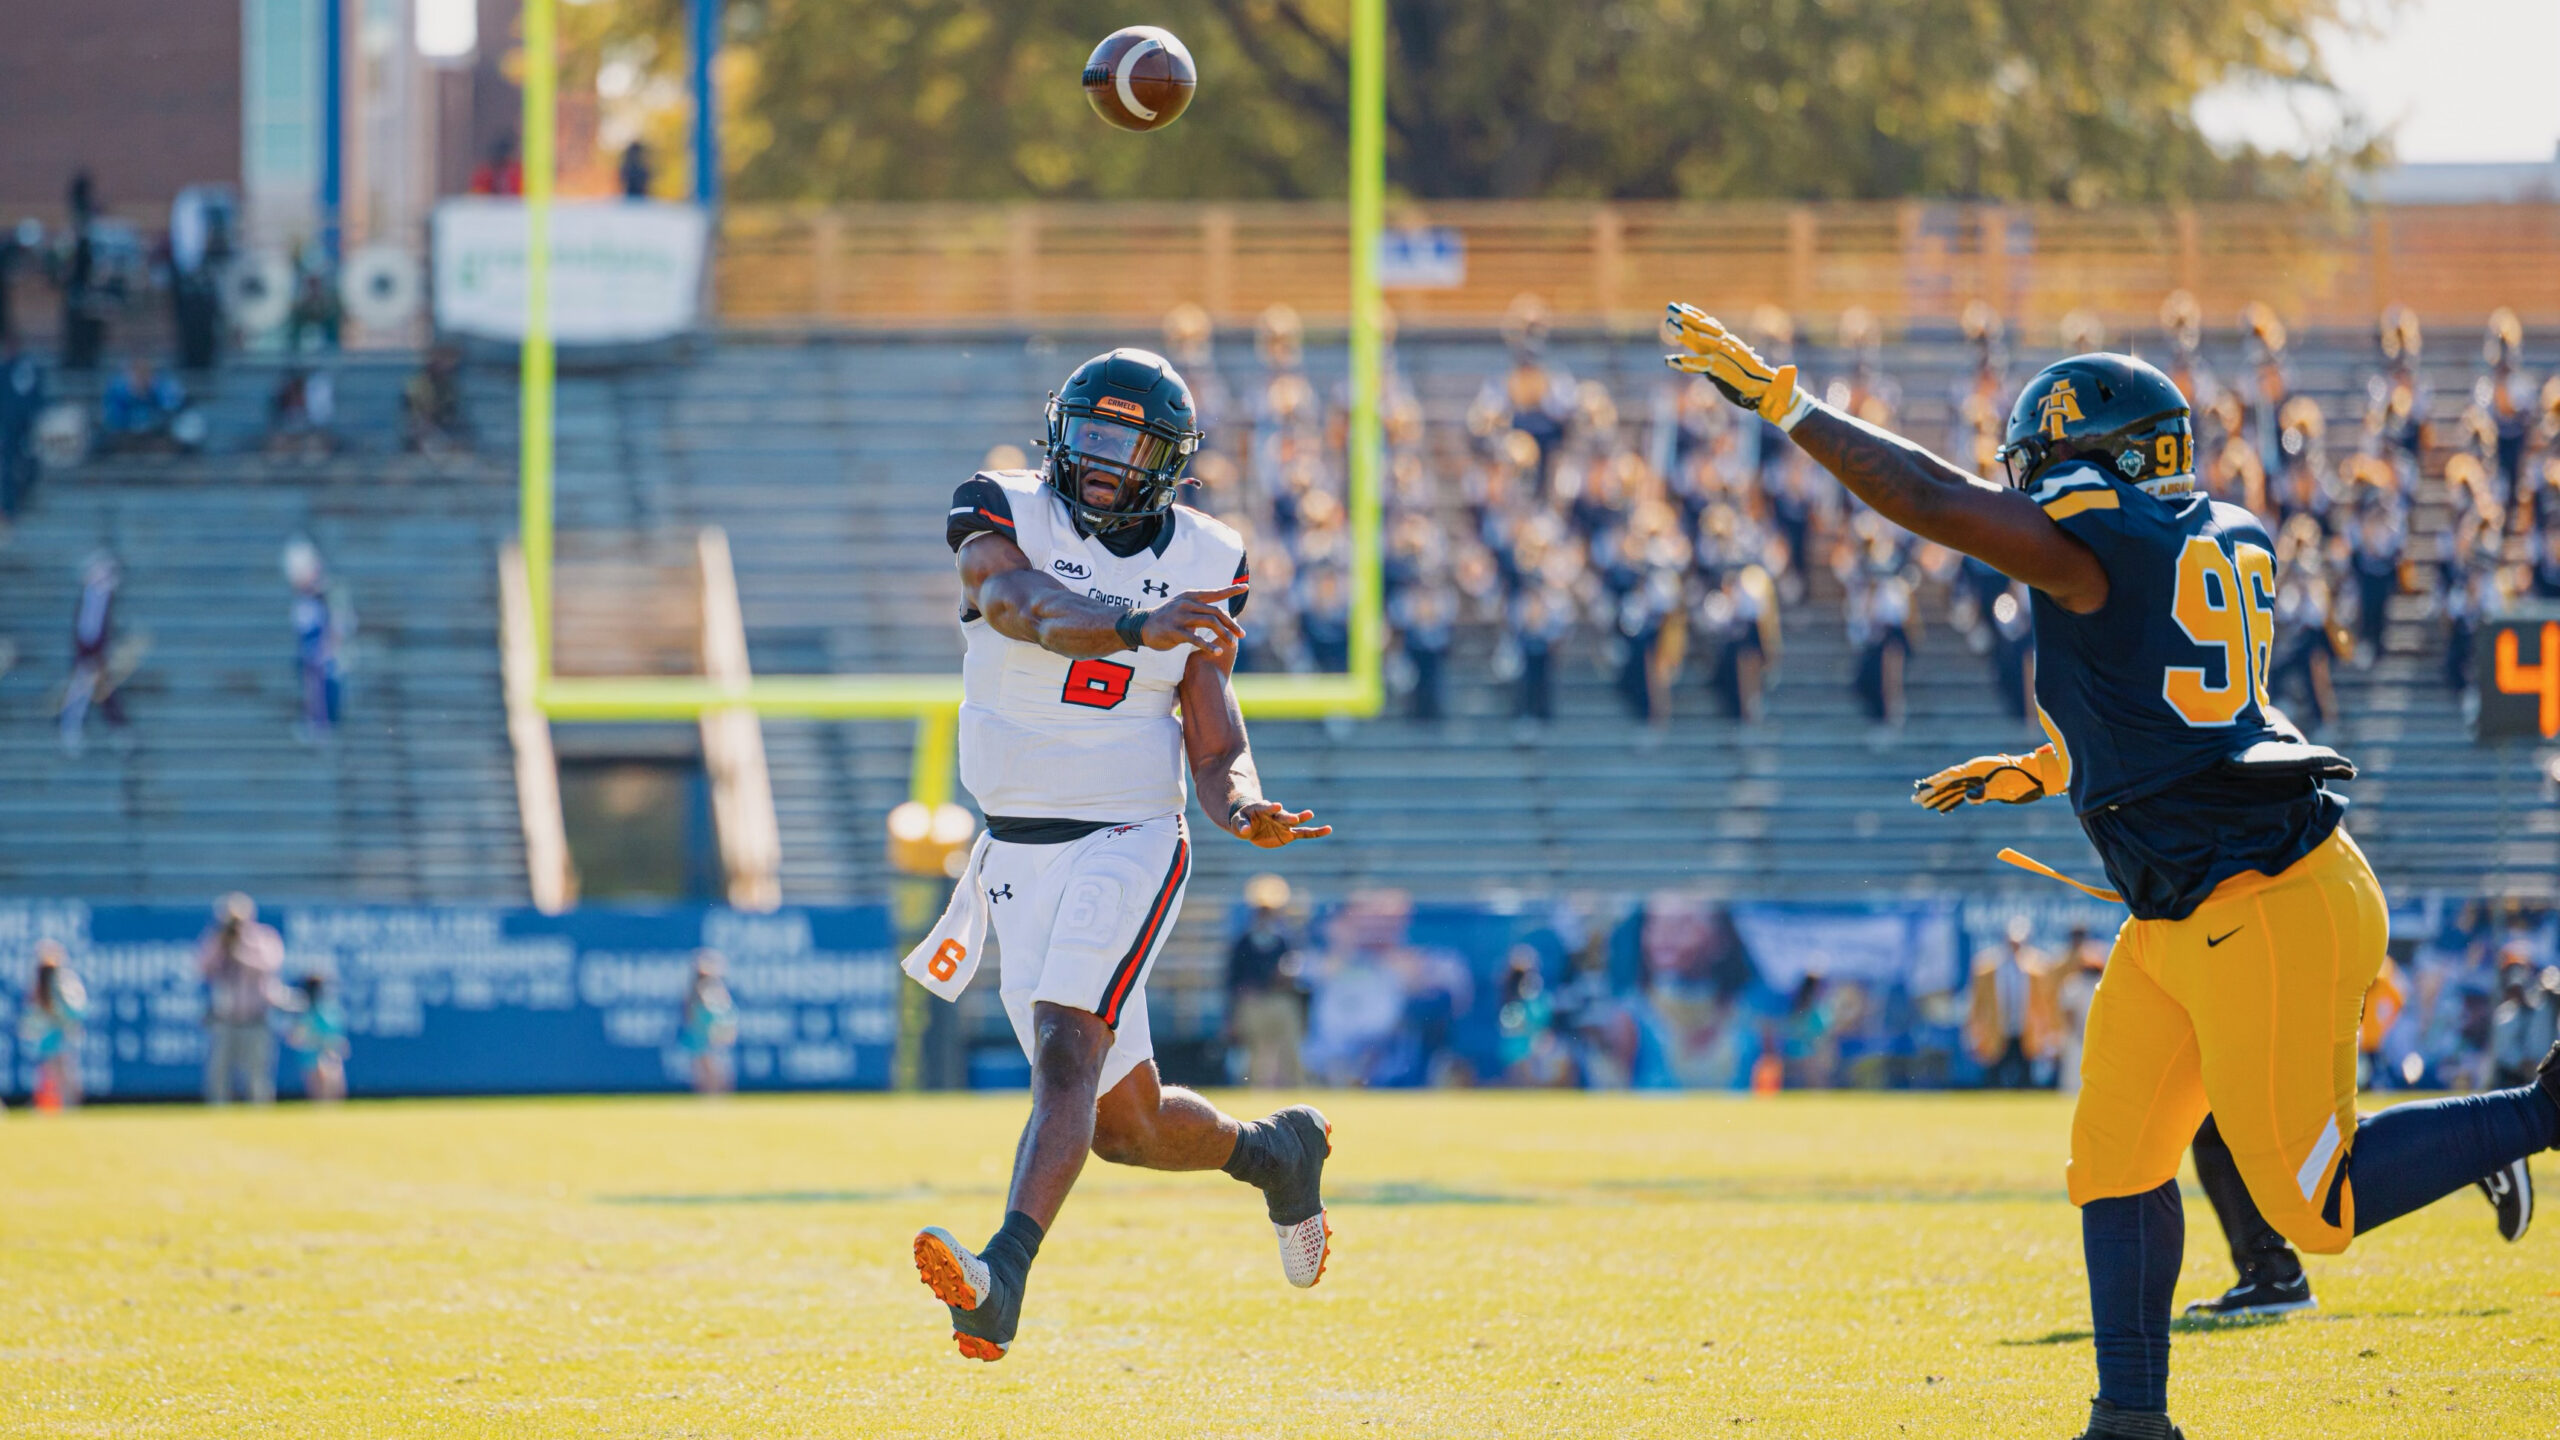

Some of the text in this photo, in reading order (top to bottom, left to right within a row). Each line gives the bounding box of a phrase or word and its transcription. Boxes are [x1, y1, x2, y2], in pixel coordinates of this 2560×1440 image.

[1054, 559, 1084, 576] CAA
[2163, 535, 2276, 728] 96
[2495, 620, 2560, 739] 4
[928, 938, 966, 982] 6
